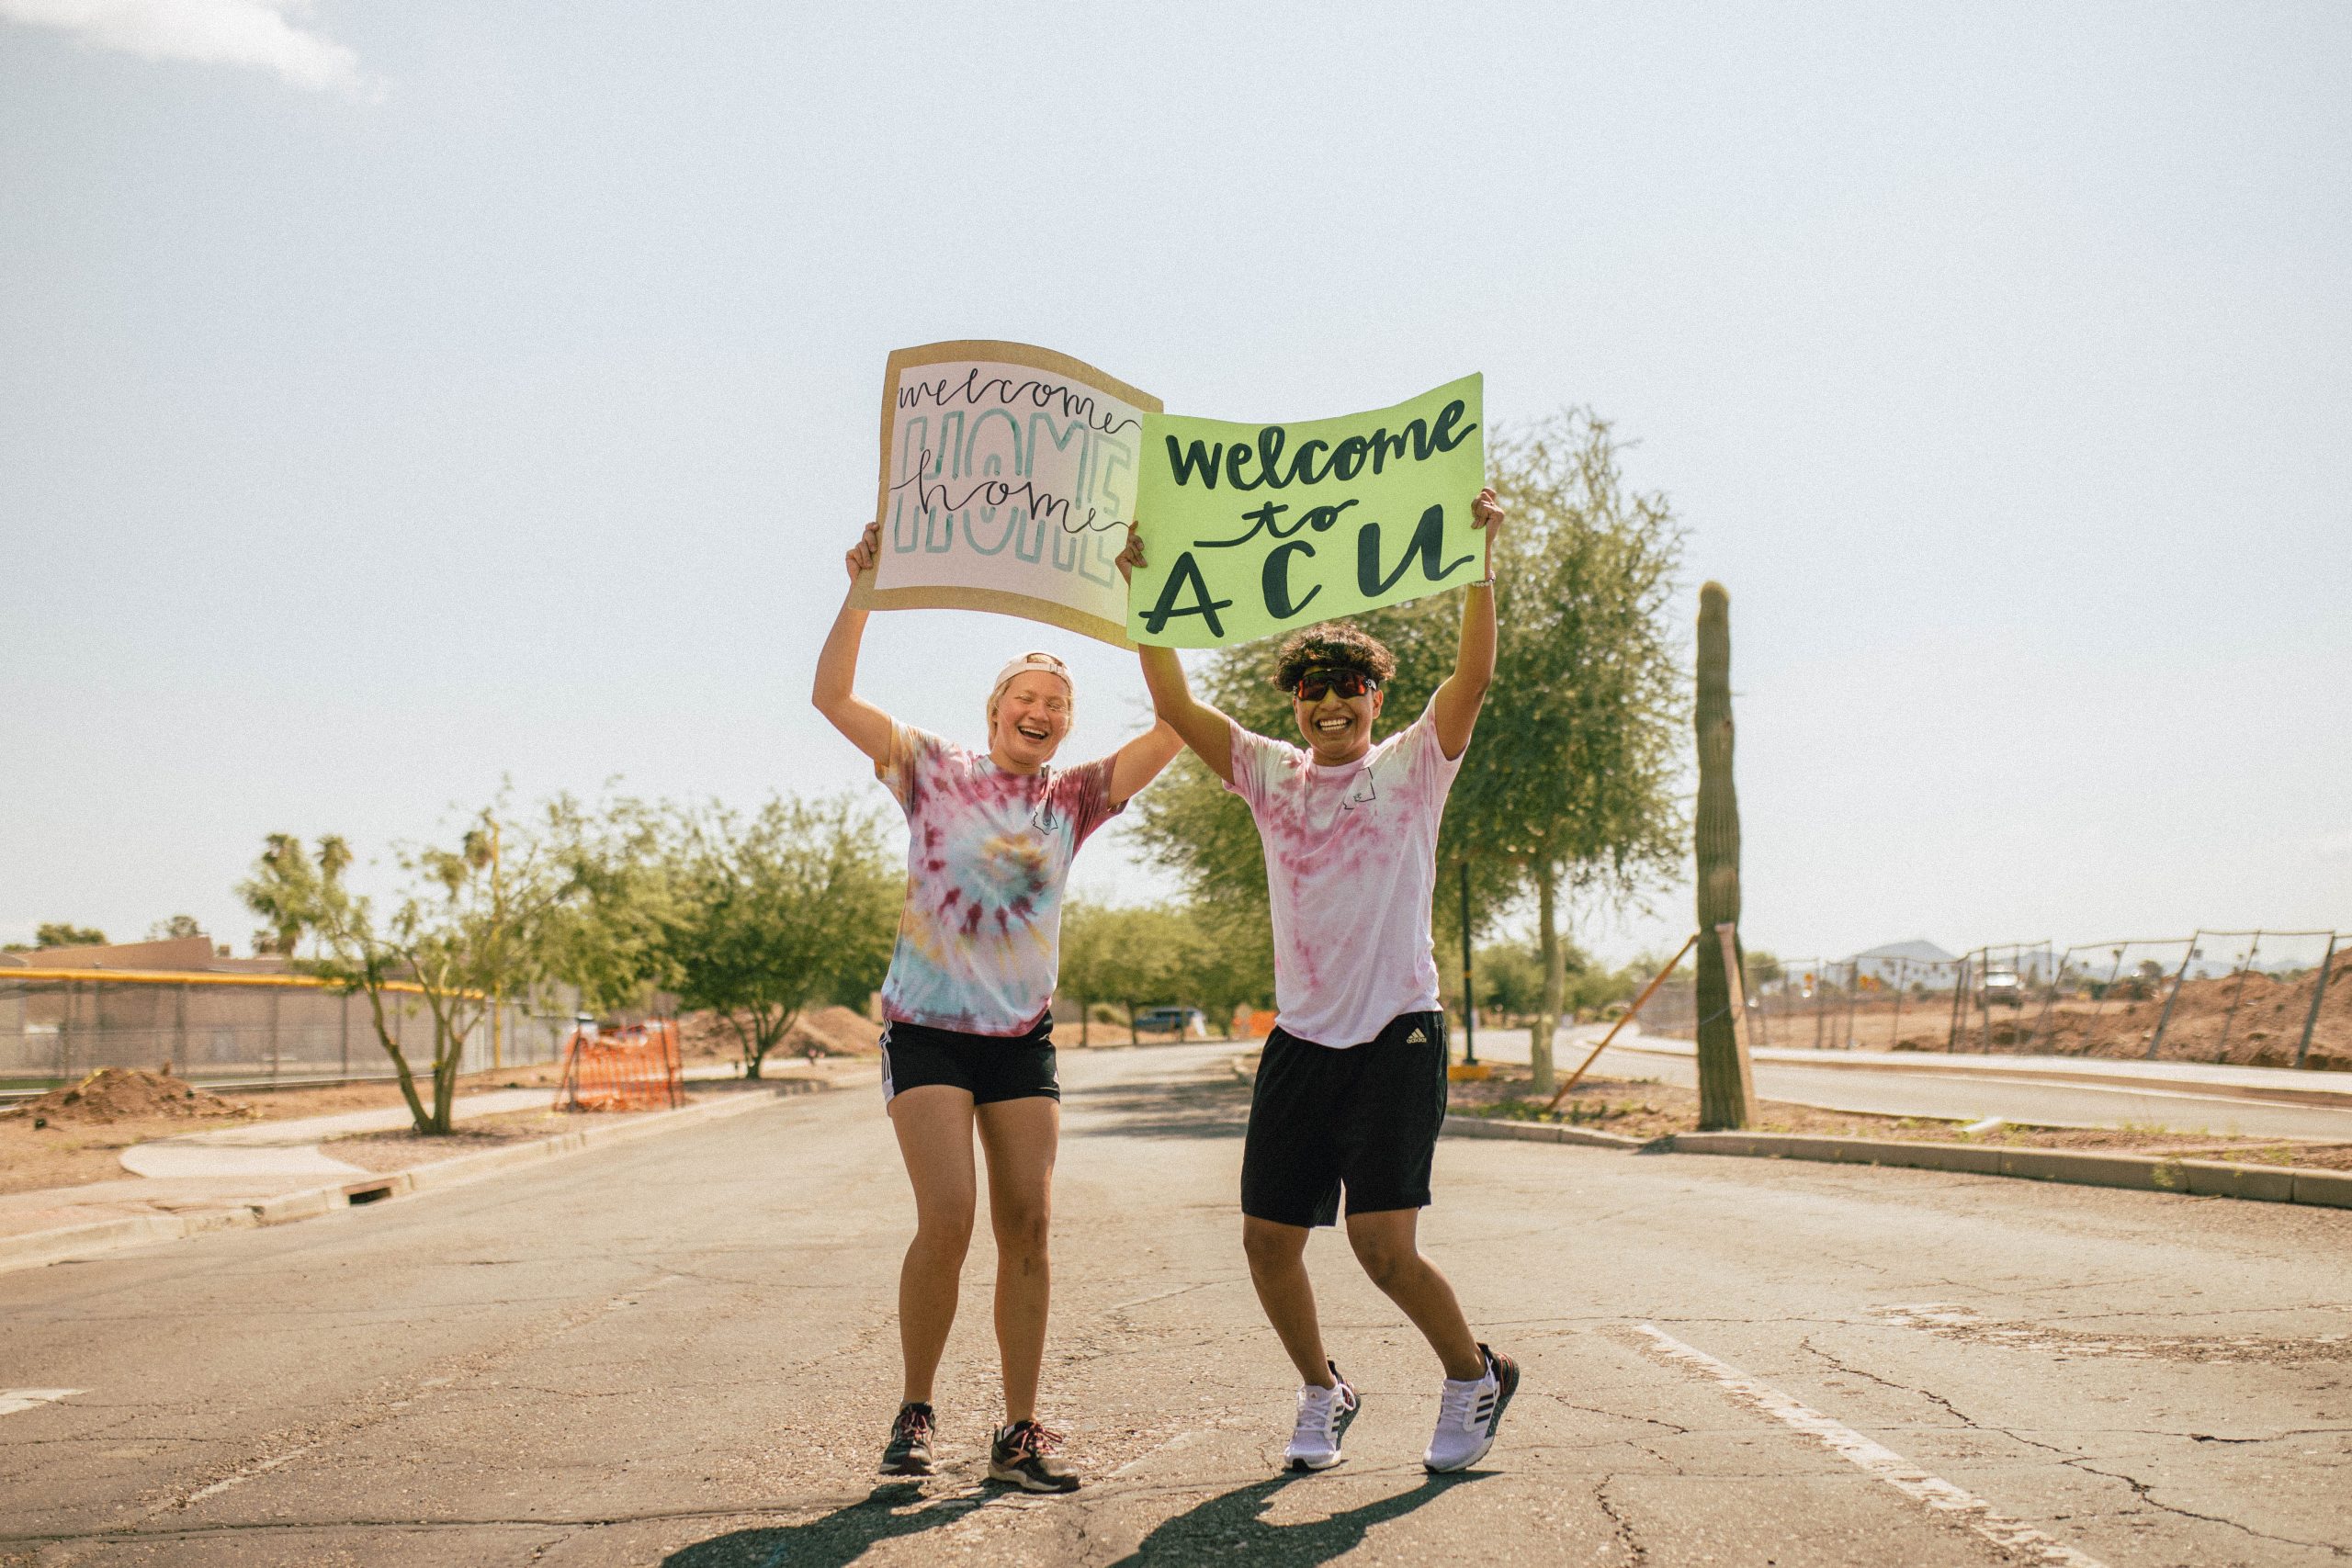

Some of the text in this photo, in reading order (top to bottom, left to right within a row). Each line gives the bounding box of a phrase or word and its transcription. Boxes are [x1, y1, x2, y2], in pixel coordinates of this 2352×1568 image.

[898, 367, 1142, 434] welcome
[889, 448, 1130, 534] home
[1193, 499, 1360, 547] to
